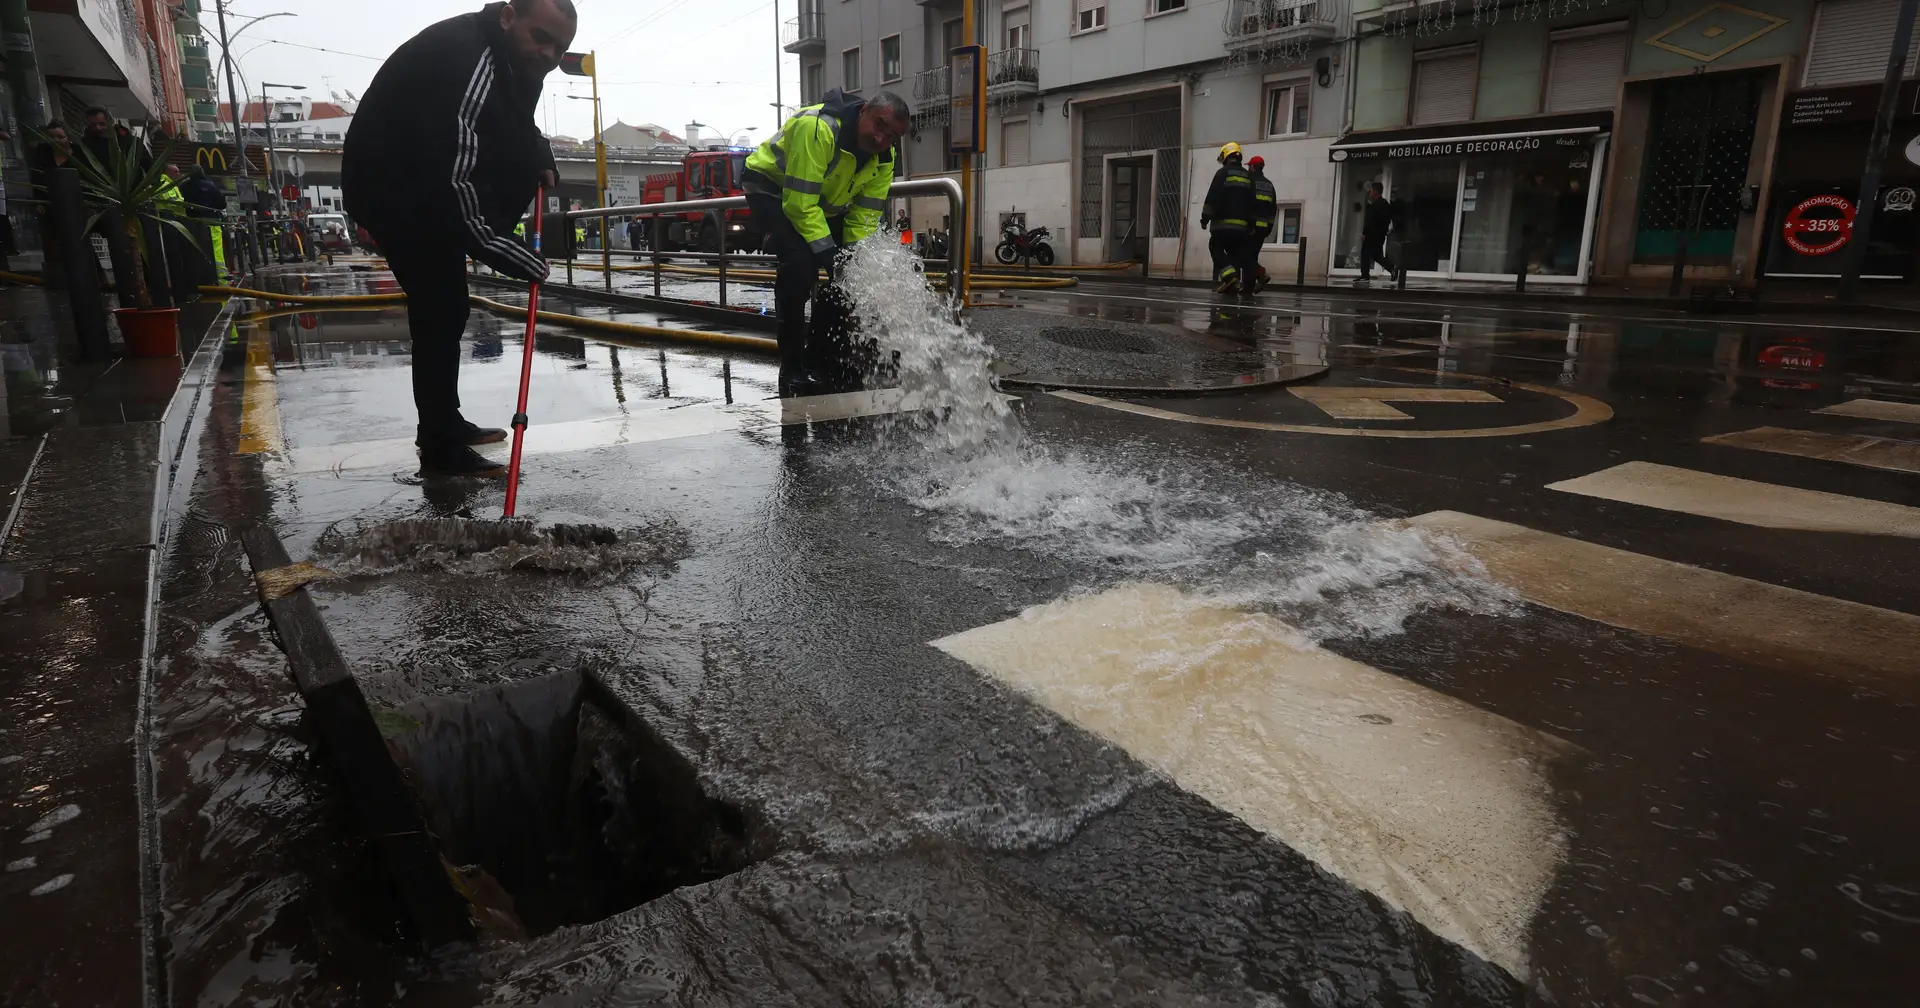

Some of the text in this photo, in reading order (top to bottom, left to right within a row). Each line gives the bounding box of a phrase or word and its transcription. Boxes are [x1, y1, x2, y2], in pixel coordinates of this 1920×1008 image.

[1388, 144, 1452, 157] MOBILIÁRIO
[1455, 143, 1463, 153] E
[1466, 137, 1540, 153] DECORAÇÃO
[1798, 196, 1849, 211] PROMOÇÃO
[1890, 191, 1911, 203] 50
[1815, 236, 1847, 253] sommiers
